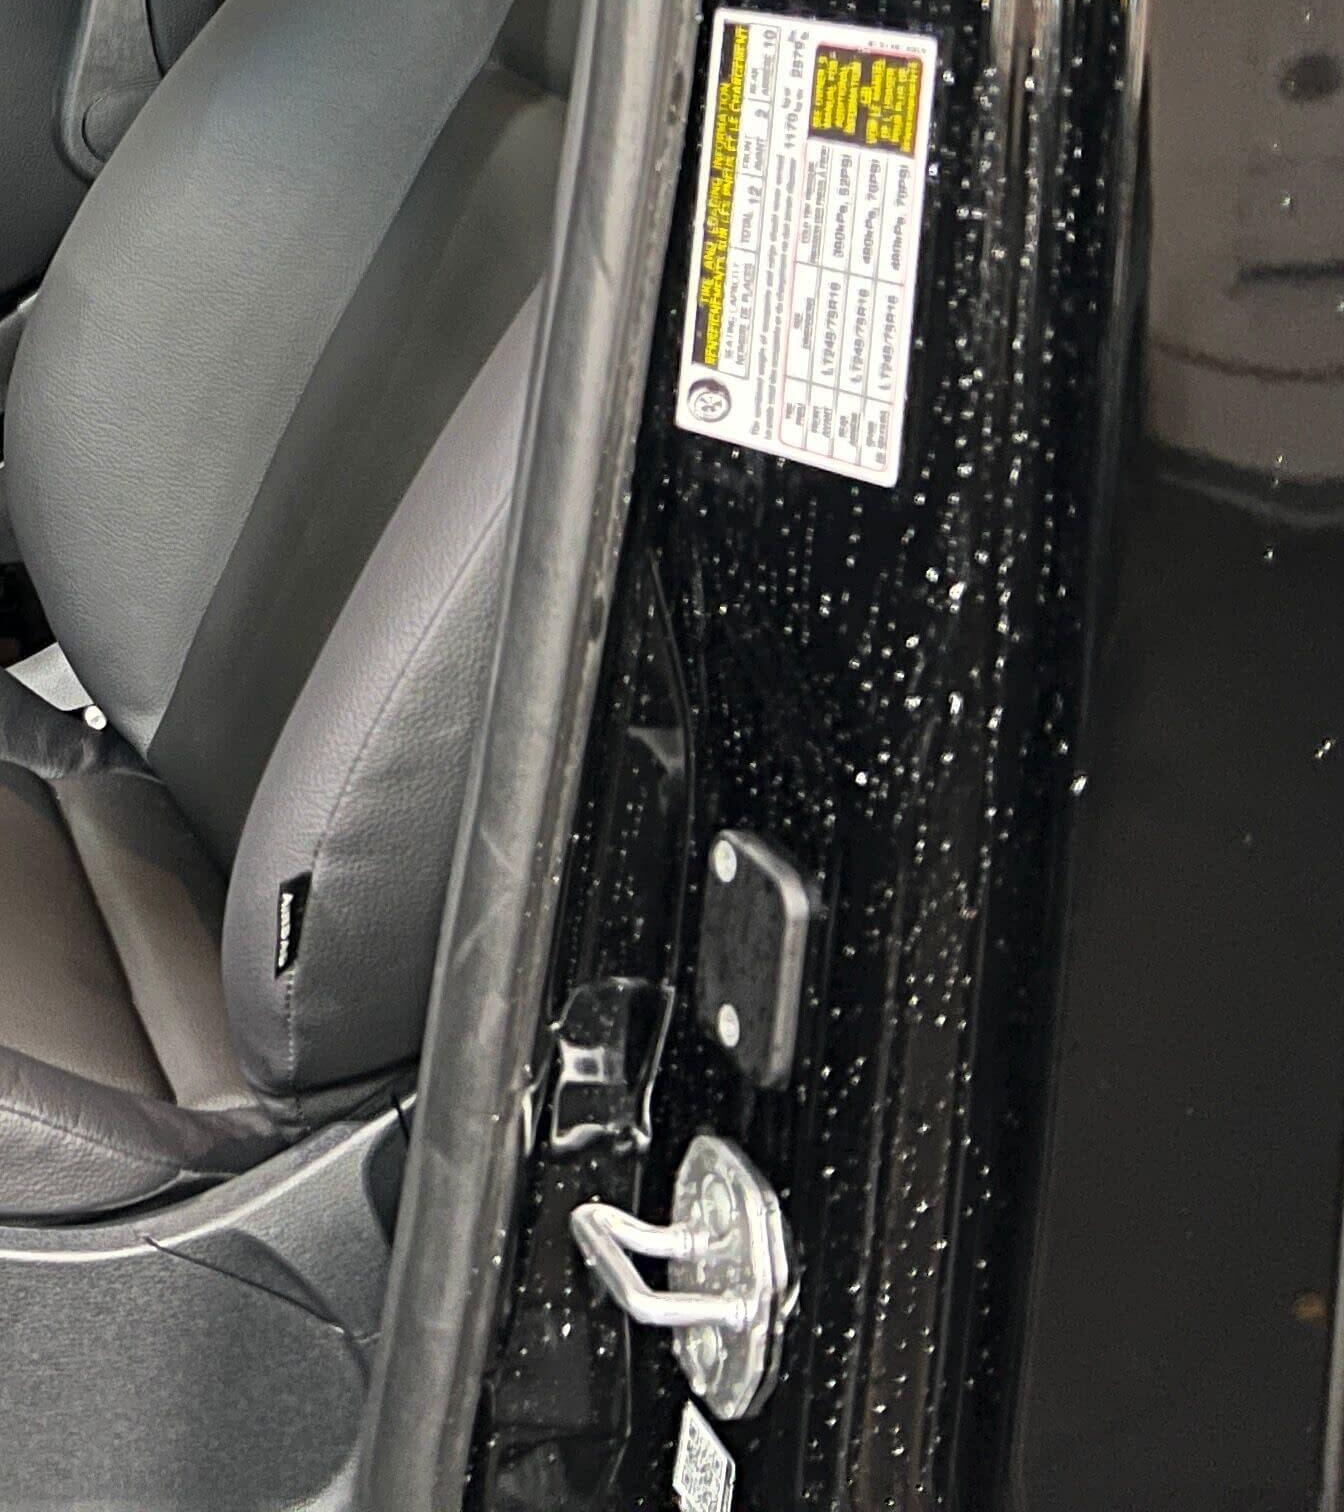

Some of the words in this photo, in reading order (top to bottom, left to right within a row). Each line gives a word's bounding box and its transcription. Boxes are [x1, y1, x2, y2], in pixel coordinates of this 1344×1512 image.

[762, 29, 776, 48] 10
[754, 107, 768, 118] 2
[712, 81, 730, 169] INFORMATION
[746, 185, 761, 204] 12
